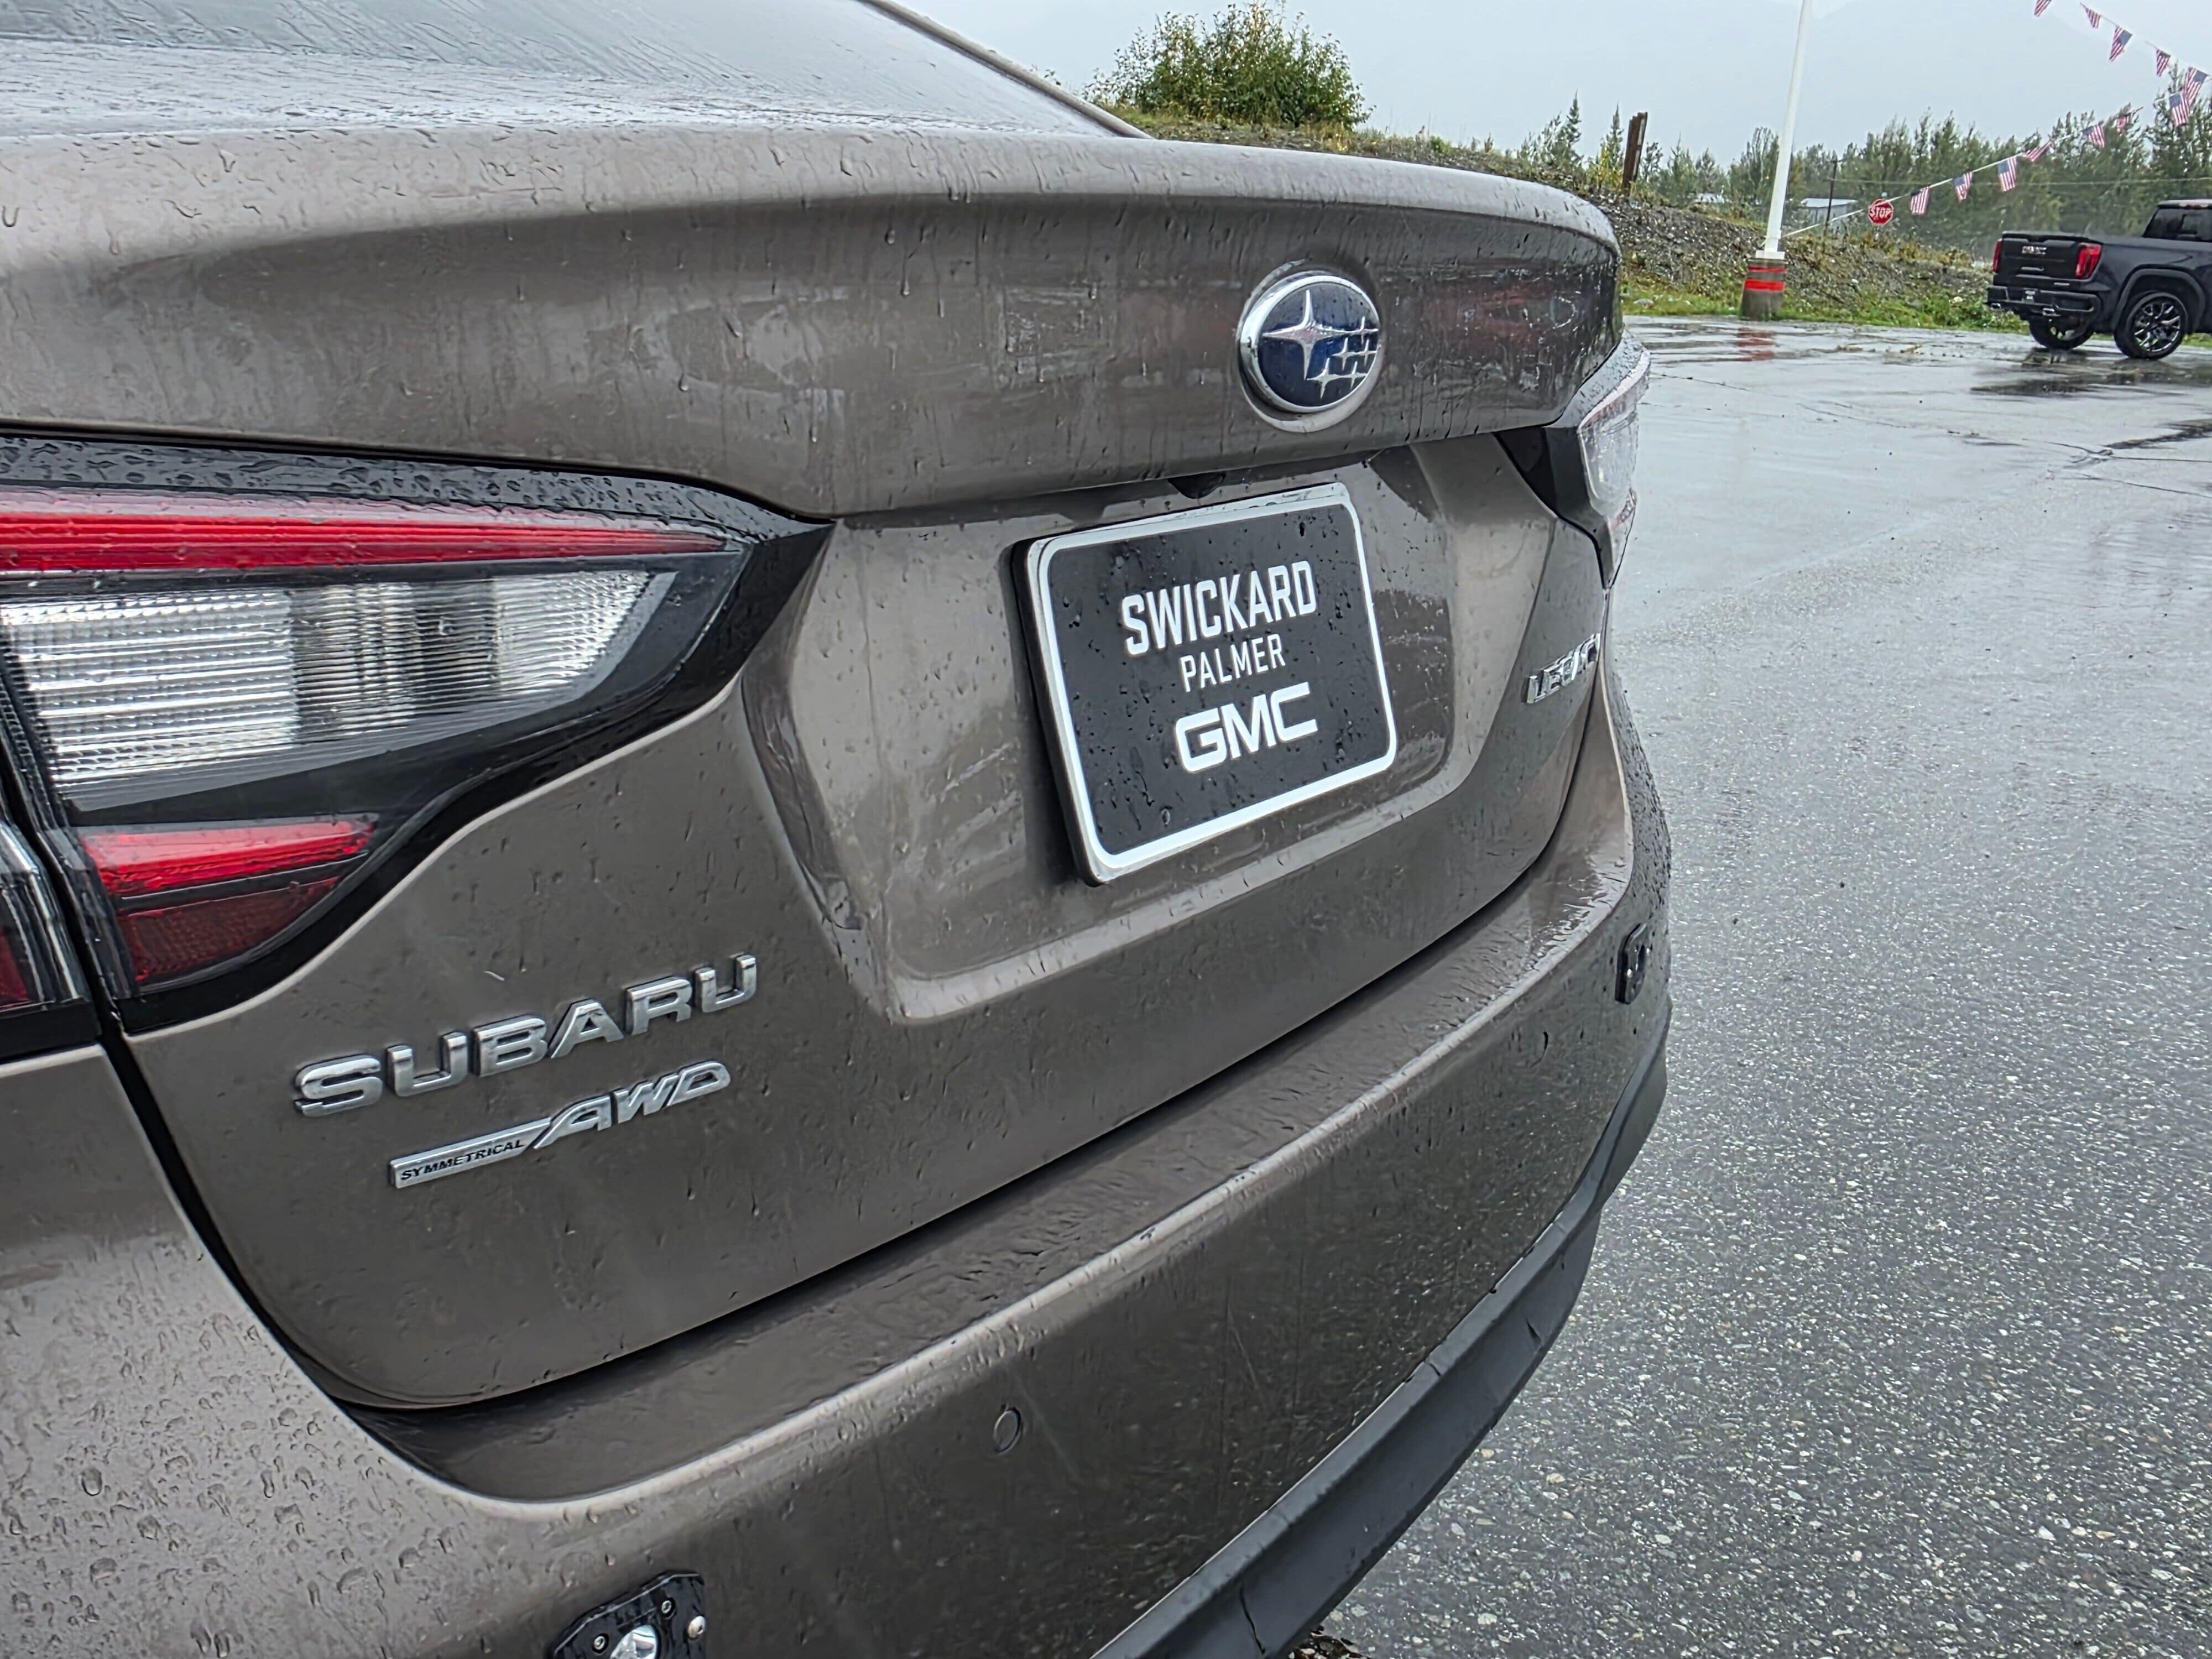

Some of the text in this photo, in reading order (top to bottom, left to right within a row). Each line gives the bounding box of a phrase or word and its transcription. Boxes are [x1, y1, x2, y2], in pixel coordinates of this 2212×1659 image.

[1870, 206, 1892, 217] STOP
[1122, 561, 1317, 655] SWICKARD
[1180, 634, 1286, 692] PALMER
[1176, 682, 1318, 772] GMC
[295, 953, 757, 1118] SUBARU
[400, 1061, 731, 1181] SYMMETRICAL AWD
